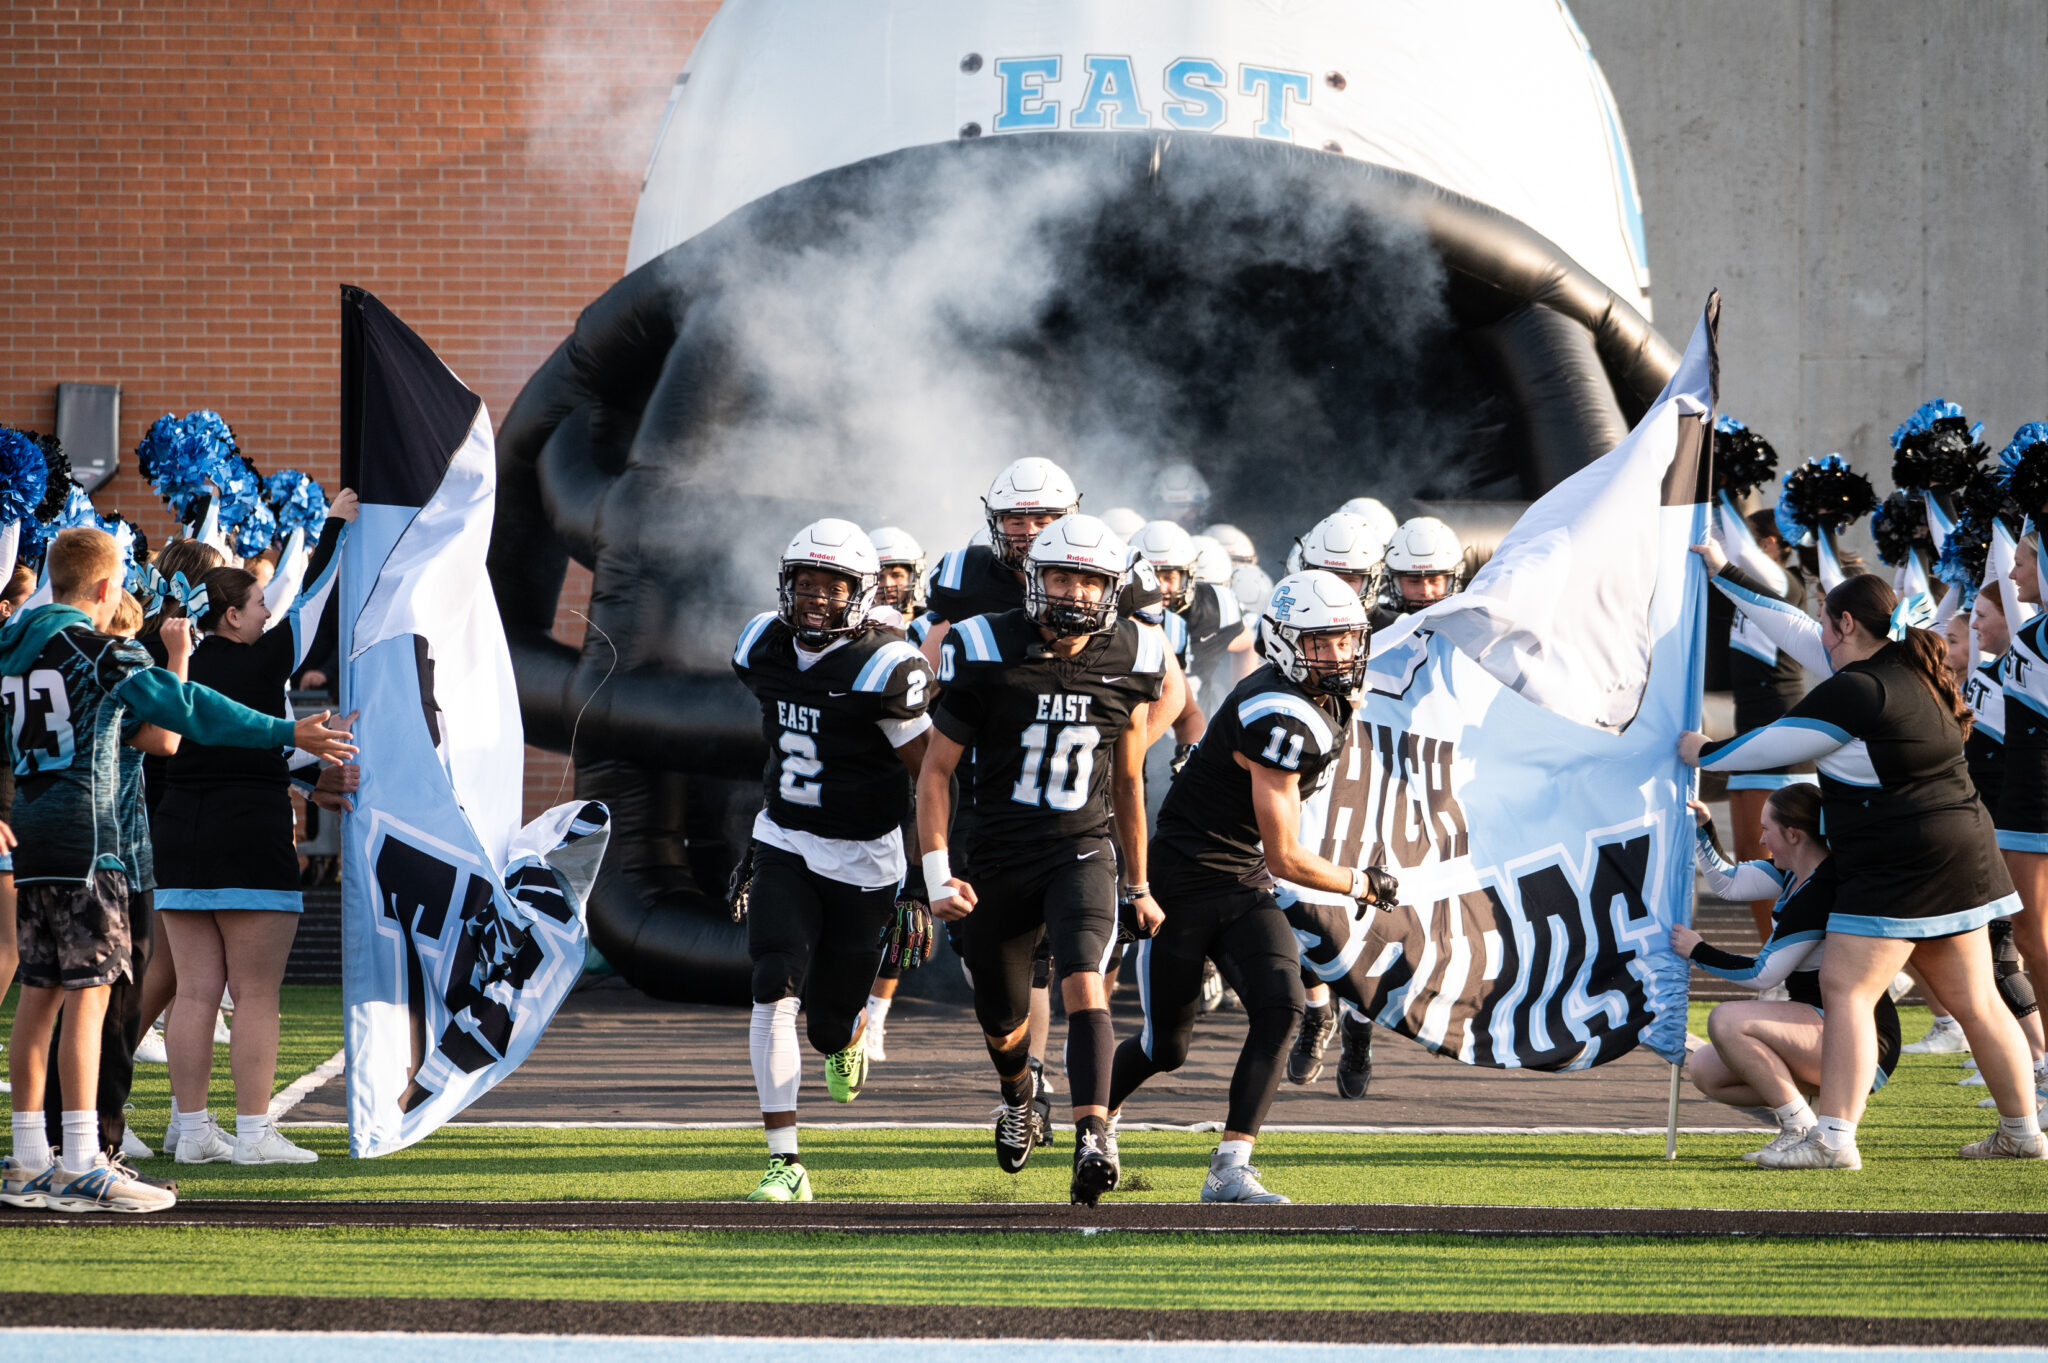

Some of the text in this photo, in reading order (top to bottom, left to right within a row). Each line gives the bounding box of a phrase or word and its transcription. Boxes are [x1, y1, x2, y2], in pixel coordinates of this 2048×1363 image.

[993, 54, 1313, 142] EAST
[809, 551, 836, 561] Riddell
[1066, 553, 1094, 563] Riddell
[1271, 585, 1296, 621] CE
[906, 669, 927, 707] 2
[777, 700, 821, 734] EAST
[1036, 694, 1092, 723] EAST
[1010, 722, 1101, 812] 10
[1261, 726, 1304, 770] 11
[778, 730, 824, 807] 2
[1318, 718, 1469, 870] HIGH
